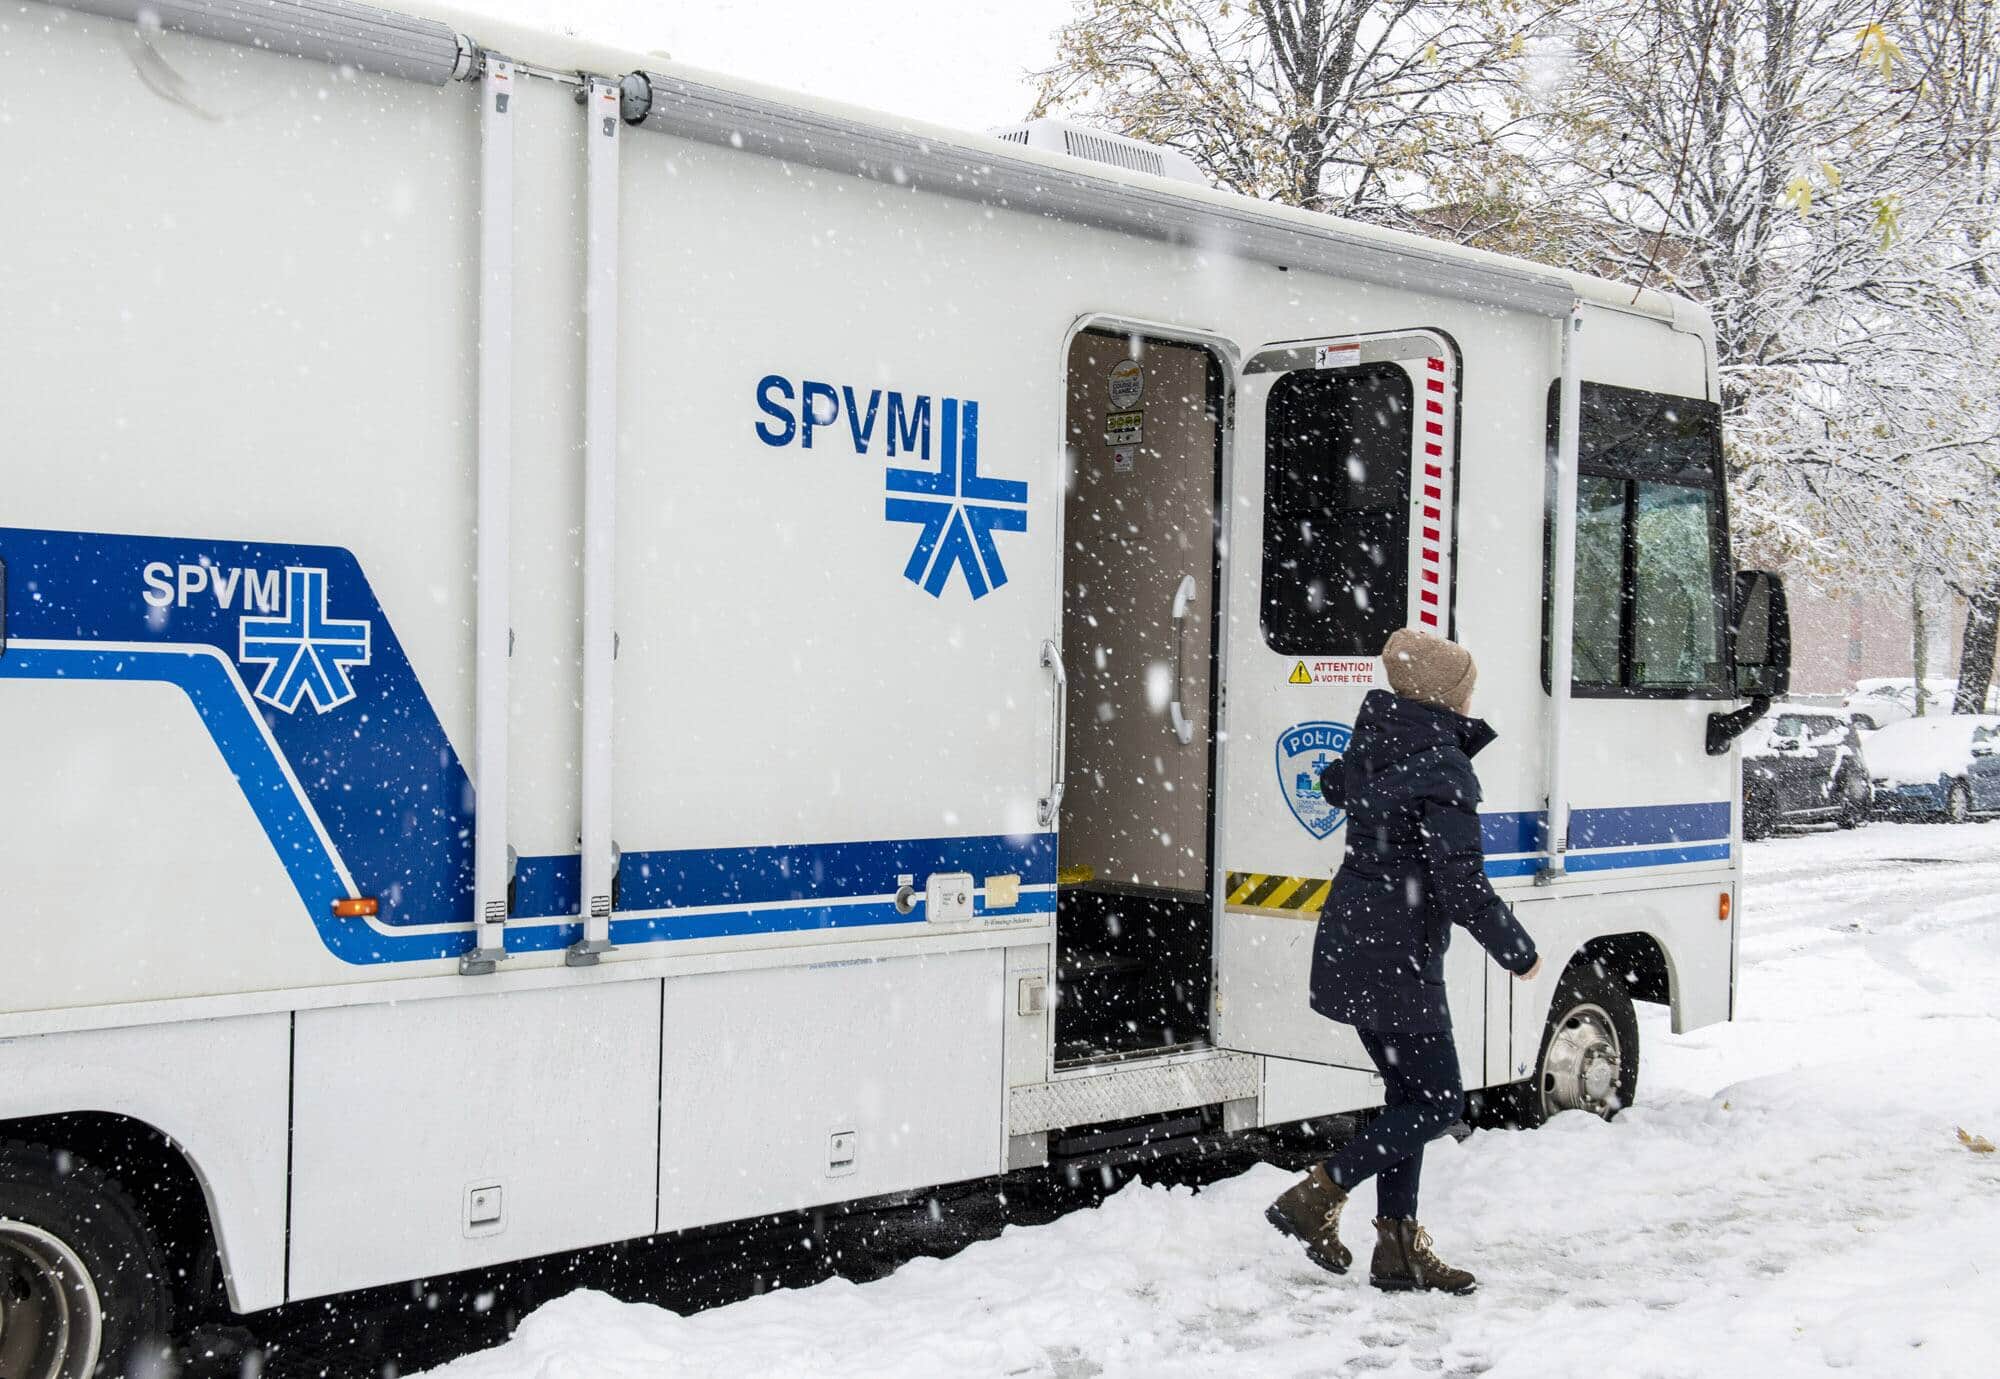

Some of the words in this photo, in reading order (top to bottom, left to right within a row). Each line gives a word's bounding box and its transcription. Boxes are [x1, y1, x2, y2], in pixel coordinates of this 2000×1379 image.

[755, 374, 931, 461] SPVM
[142, 561, 280, 612] SPVM
[1314, 662, 1373, 672] ATTENTION
